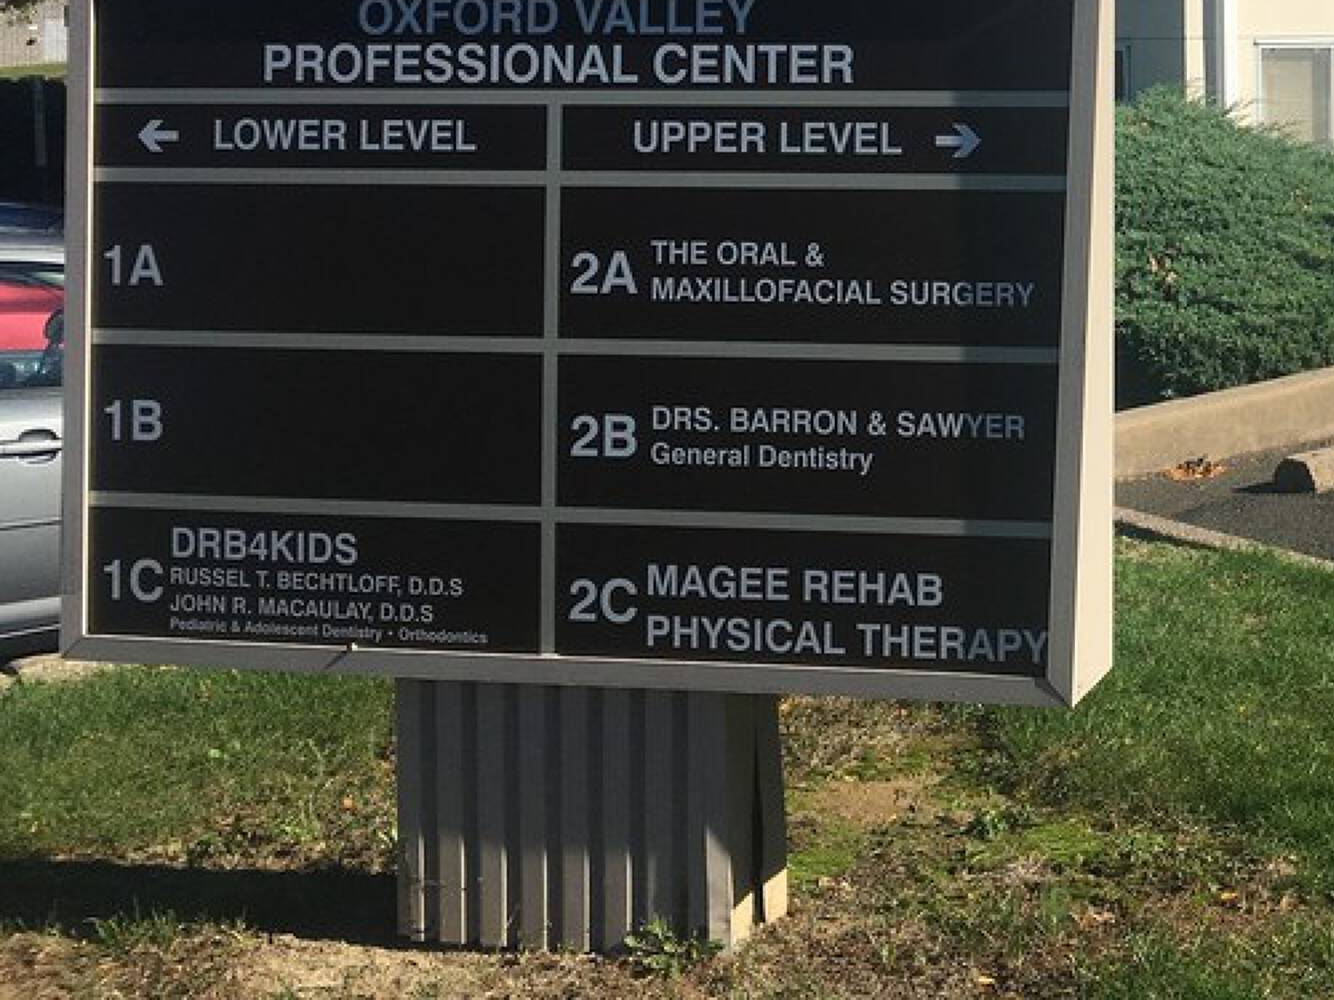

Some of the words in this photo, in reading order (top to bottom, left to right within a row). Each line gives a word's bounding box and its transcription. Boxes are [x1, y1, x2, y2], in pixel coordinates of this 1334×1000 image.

[264, 43, 638, 83] PROFESSIONAL
[654, 43, 853, 83] CENTER
[215, 118, 346, 150] LOWER
[360, 120, 477, 150] LEVEL
[634, 120, 765, 152] UPPER
[781, 122, 902, 154] LEVEL
[104, 245, 163, 285] 1A
[571, 251, 638, 294] 2A
[651, 240, 707, 264] THE
[717, 241, 797, 266] ORAL
[805, 243, 824, 267] &
[652, 277, 881, 304] MAXILLOFACIAL
[890, 280, 1035, 307] SURGERY
[104, 400, 162, 440] 1B
[571, 414, 637, 456] 2B
[653, 406, 720, 432] DRS.
[731, 408, 856, 435] BARRON
[867, 411, 886, 435] &
[898, 411, 1024, 438] SAWYER
[651, 442, 749, 467] General
[760, 445, 873, 475] Dentistry
[172, 527, 358, 565] DRB4KIDS
[104, 559, 163, 602] 1C
[170, 566, 251, 587] RUSSEL
[256, 570, 270, 589] T.
[408, 576, 464, 597] D.D.S
[648, 564, 789, 600] MAGEE
[804, 570, 942, 606] REHAB
[170, 594, 226, 613] JOHN
[232, 597, 251, 614] R.
[380, 603, 433, 622] D.D.S
[568, 578, 637, 623] 2C
[648, 616, 846, 654] PHYSICAL
[858, 623, 1048, 663] THERAPY
